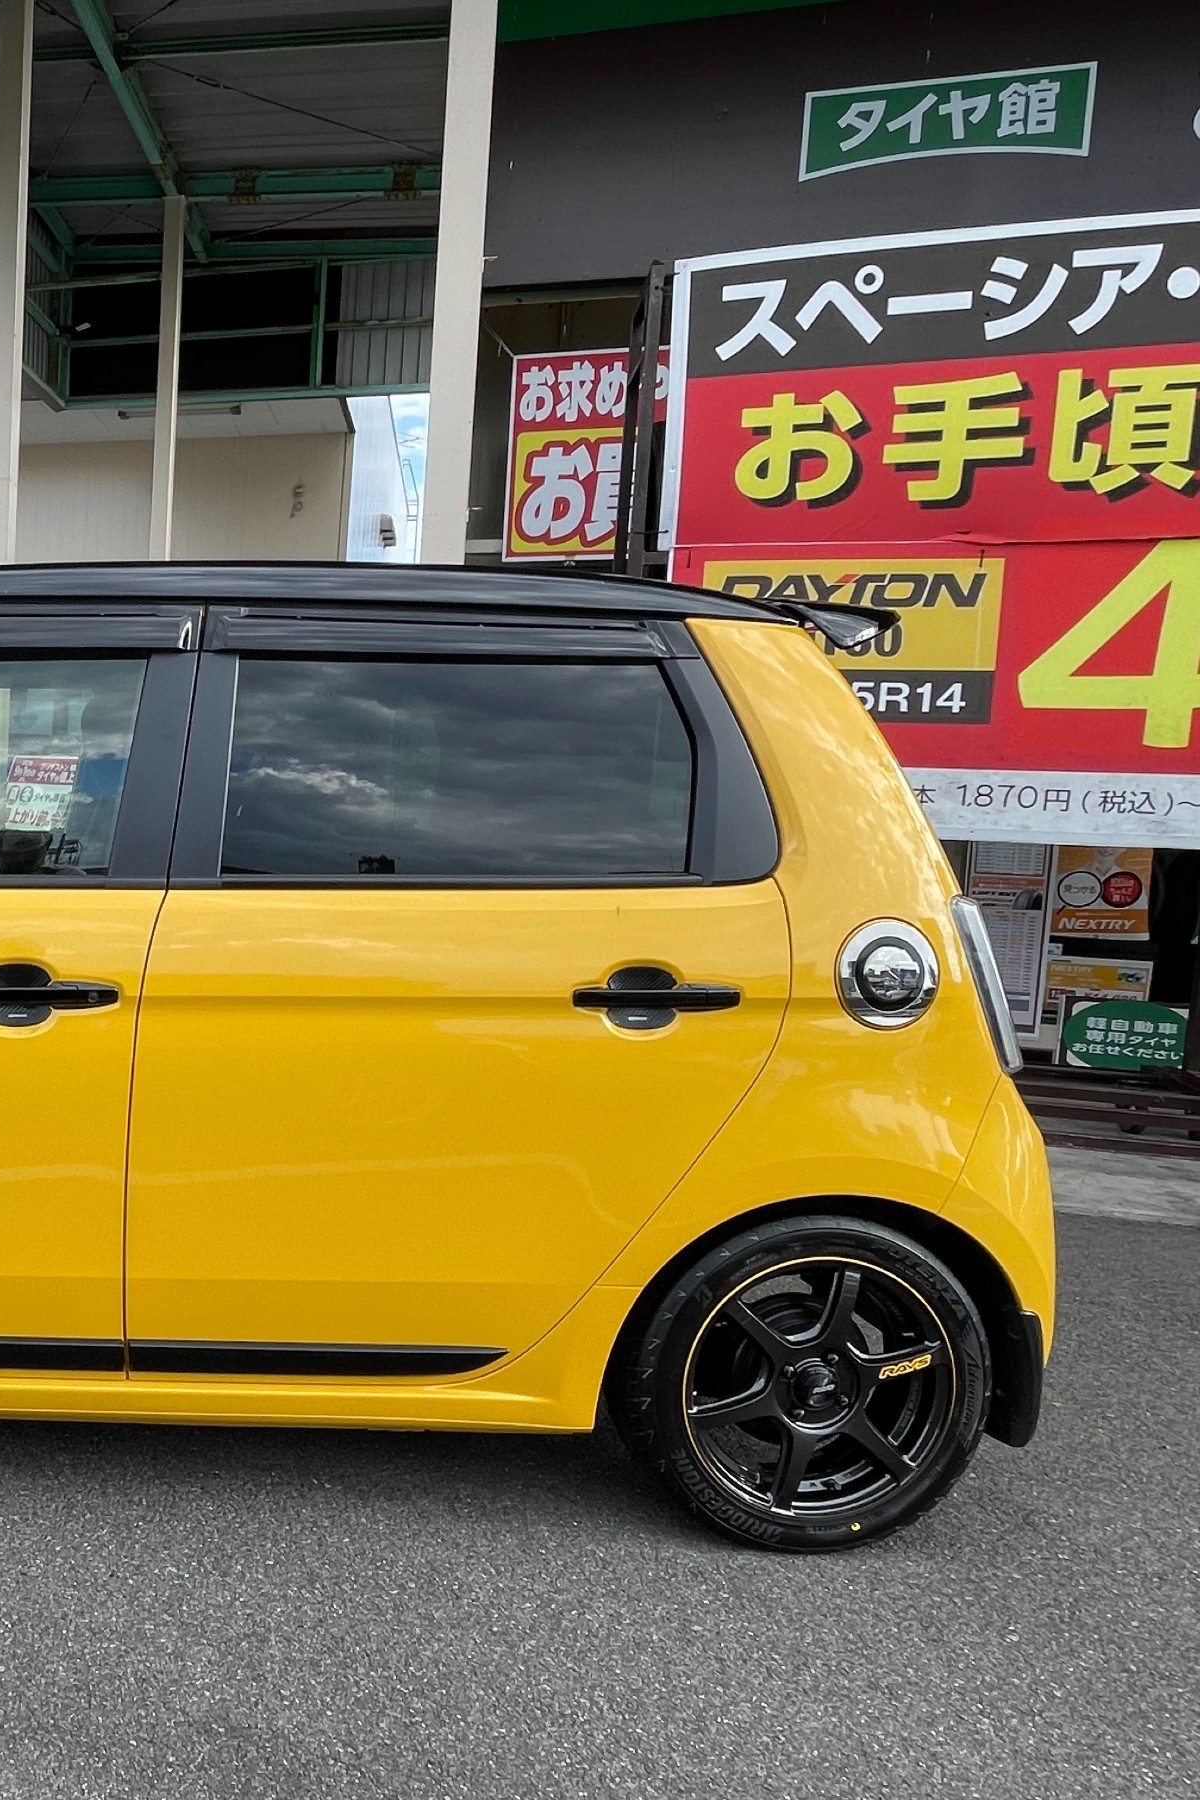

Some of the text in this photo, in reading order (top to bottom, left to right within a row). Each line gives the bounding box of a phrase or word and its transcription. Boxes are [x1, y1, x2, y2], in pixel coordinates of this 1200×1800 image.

[837, 79, 1060, 151] タイヤ館
[721, 573, 987, 608] DAYTON
[1058, 917, 1136, 930] NEXTRY
[1086, 1016, 1178, 1035] 軽自動車
[1085, 1029, 1177, 1048] 専用タイヤ
[1072, 1042, 1185, 1060] お任せください
[878, 1353, 932, 1379] RAYS
